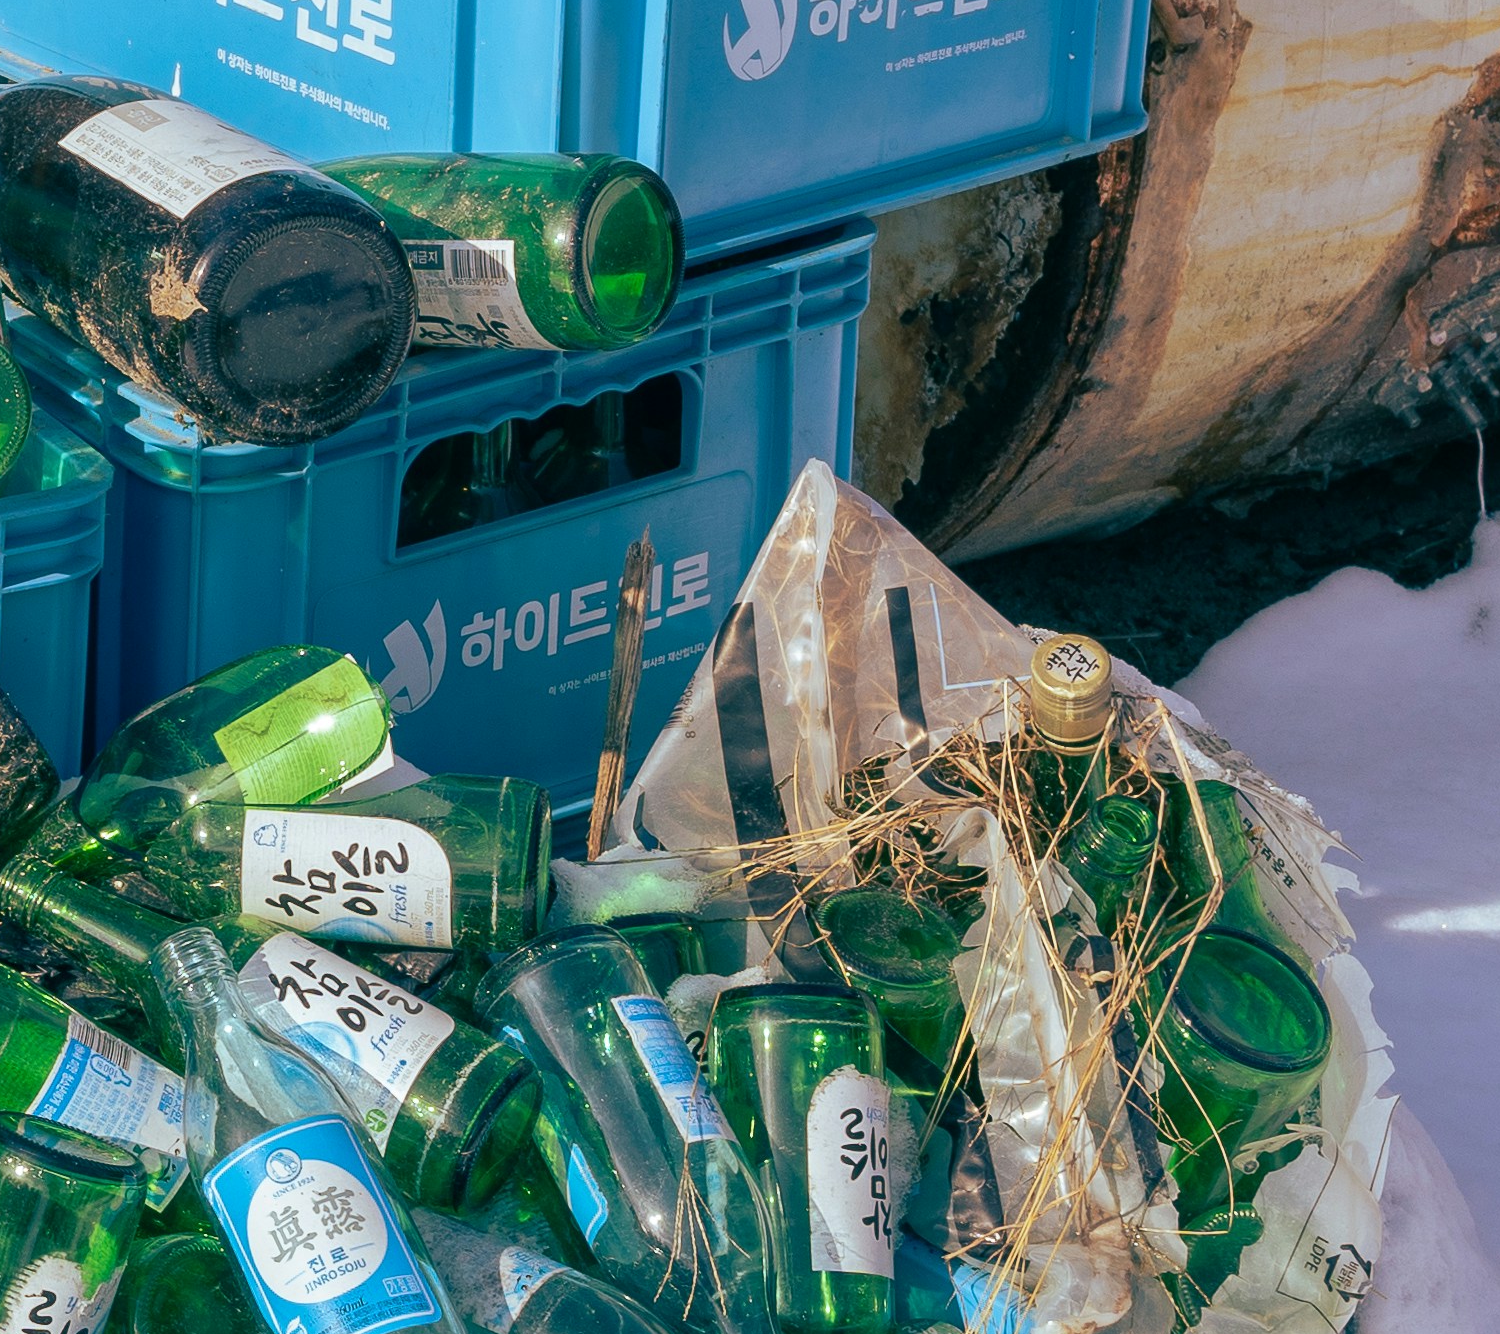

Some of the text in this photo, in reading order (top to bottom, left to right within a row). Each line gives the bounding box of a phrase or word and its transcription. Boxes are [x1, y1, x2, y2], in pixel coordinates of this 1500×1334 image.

[217, 47, 391, 130] 이 상자는 하이트진로 주식회사의 재산입니다.
[386, 882, 414, 928] fresh
[370, 1014, 407, 1061] fresh
[405, 1028, 428, 1057] 360mL
[272, 1174, 316, 1201] SINCE 1924
[1303, 1235, 1330, 1274] LDPE
[304, 1256, 368, 1295] JINRO SOJU
